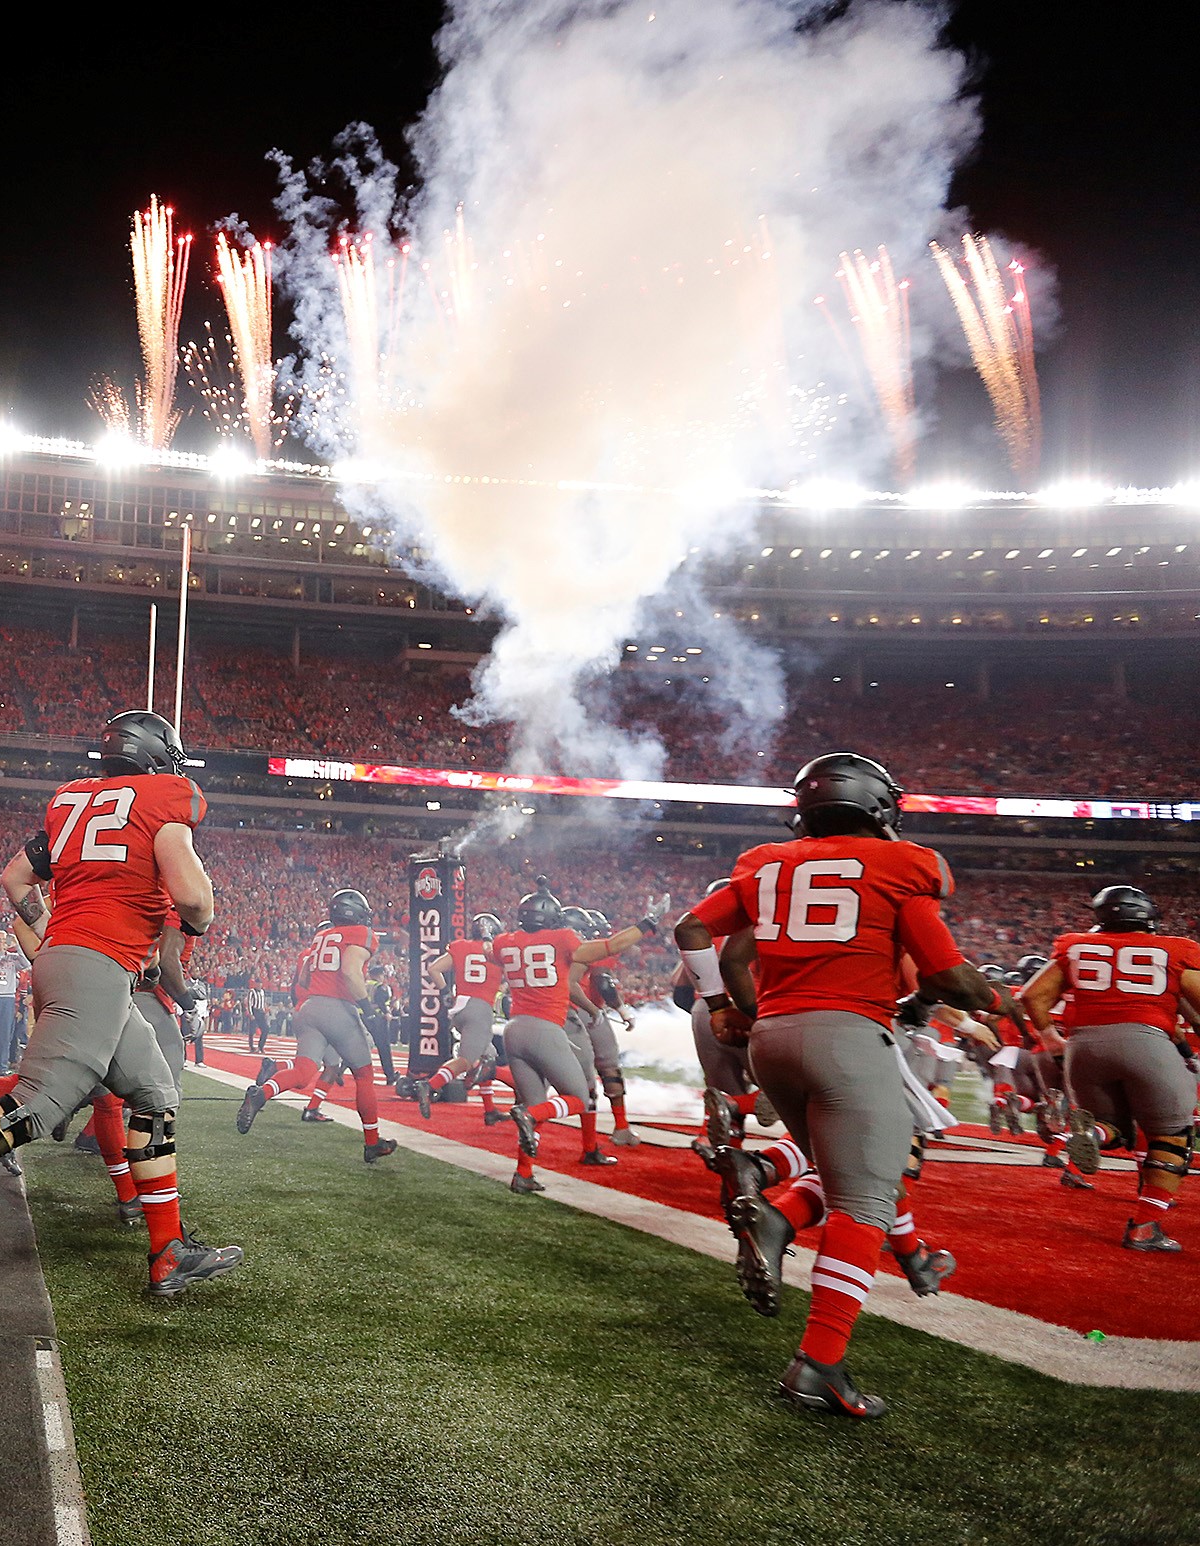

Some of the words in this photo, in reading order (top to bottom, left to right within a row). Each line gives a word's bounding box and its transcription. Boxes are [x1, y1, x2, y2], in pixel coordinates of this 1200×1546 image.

[49, 786, 138, 864] 72
[753, 857, 866, 943] 16
[418, 908, 441, 1056] BUCKEYES
[464, 953, 488, 984] 6
[500, 943, 559, 988] 28
[1066, 943, 1169, 997] 69
